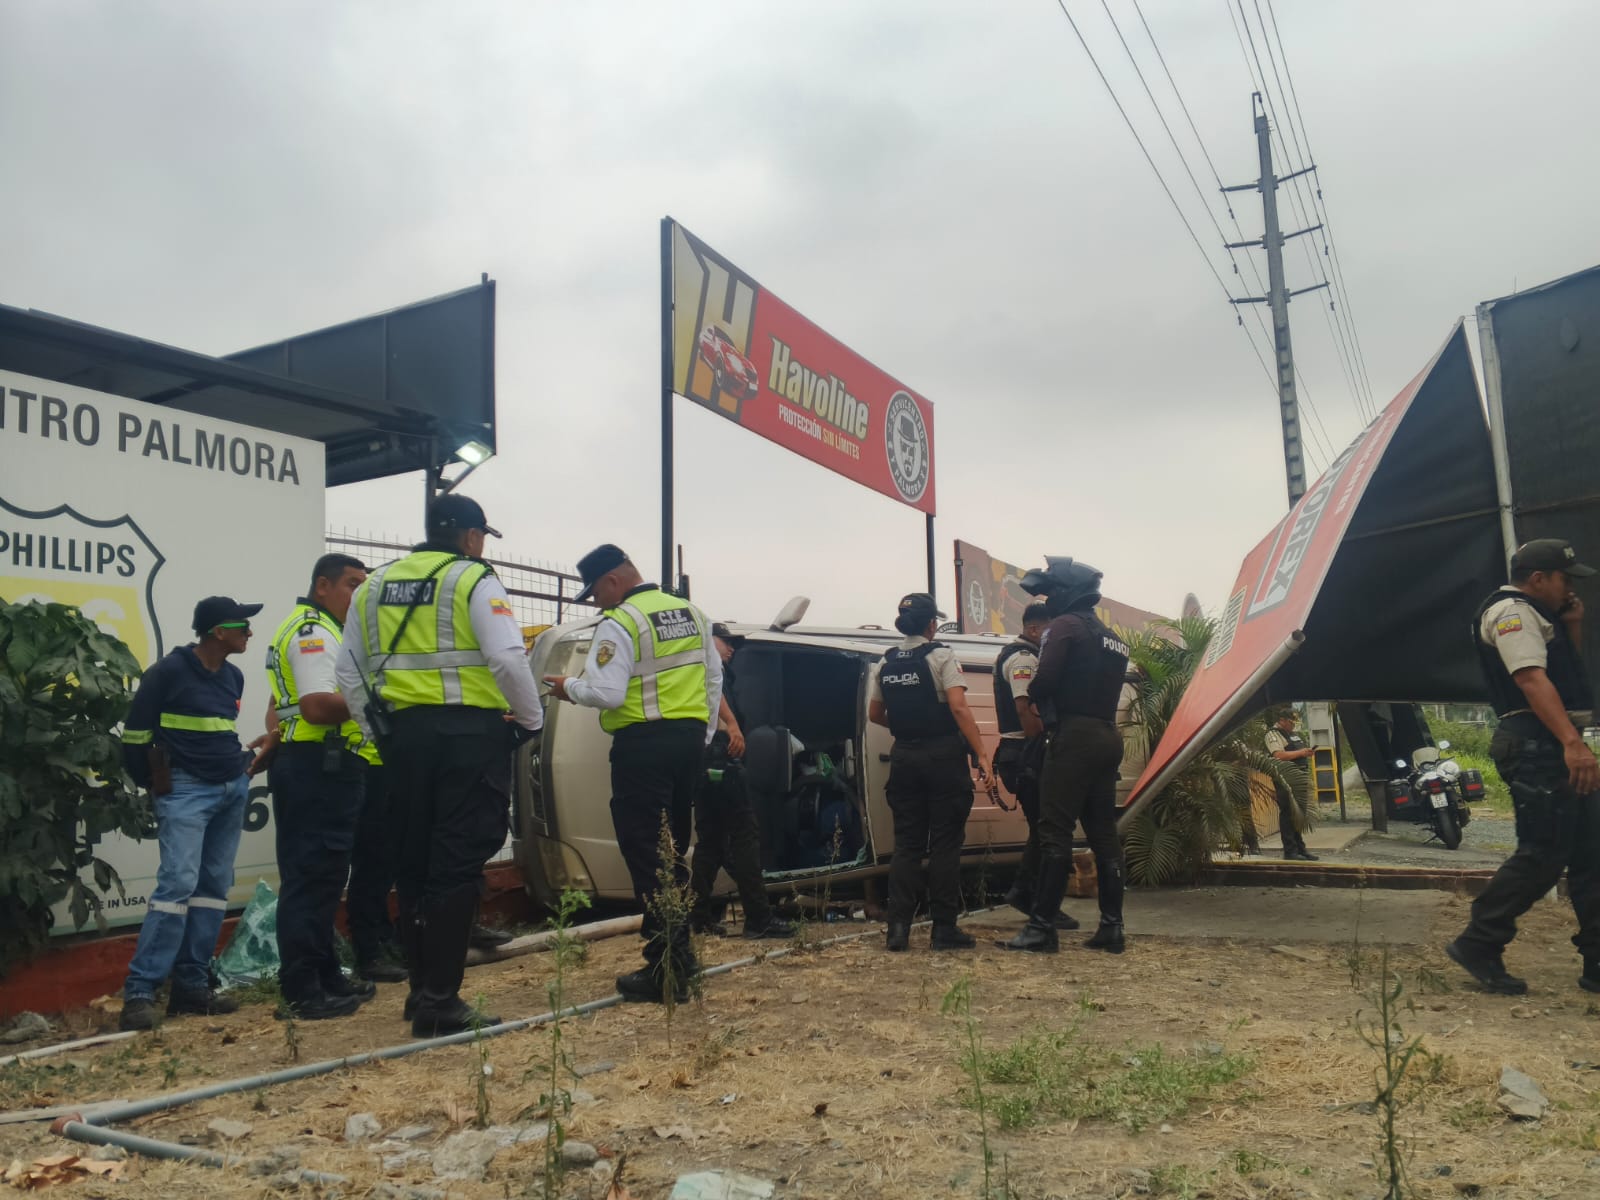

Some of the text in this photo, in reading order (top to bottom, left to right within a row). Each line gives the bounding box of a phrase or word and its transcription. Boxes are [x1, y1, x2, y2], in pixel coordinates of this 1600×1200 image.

[769, 335, 868, 441] Havoline
[0, 385, 300, 486] TRO PALMORA
[822, 428, 834, 448] SIN
[385, 581, 432, 603] TRANSO
[656, 620, 698, 641] TRANSITO
[107, 898, 120, 909] IN
[122, 895, 147, 907] USA
